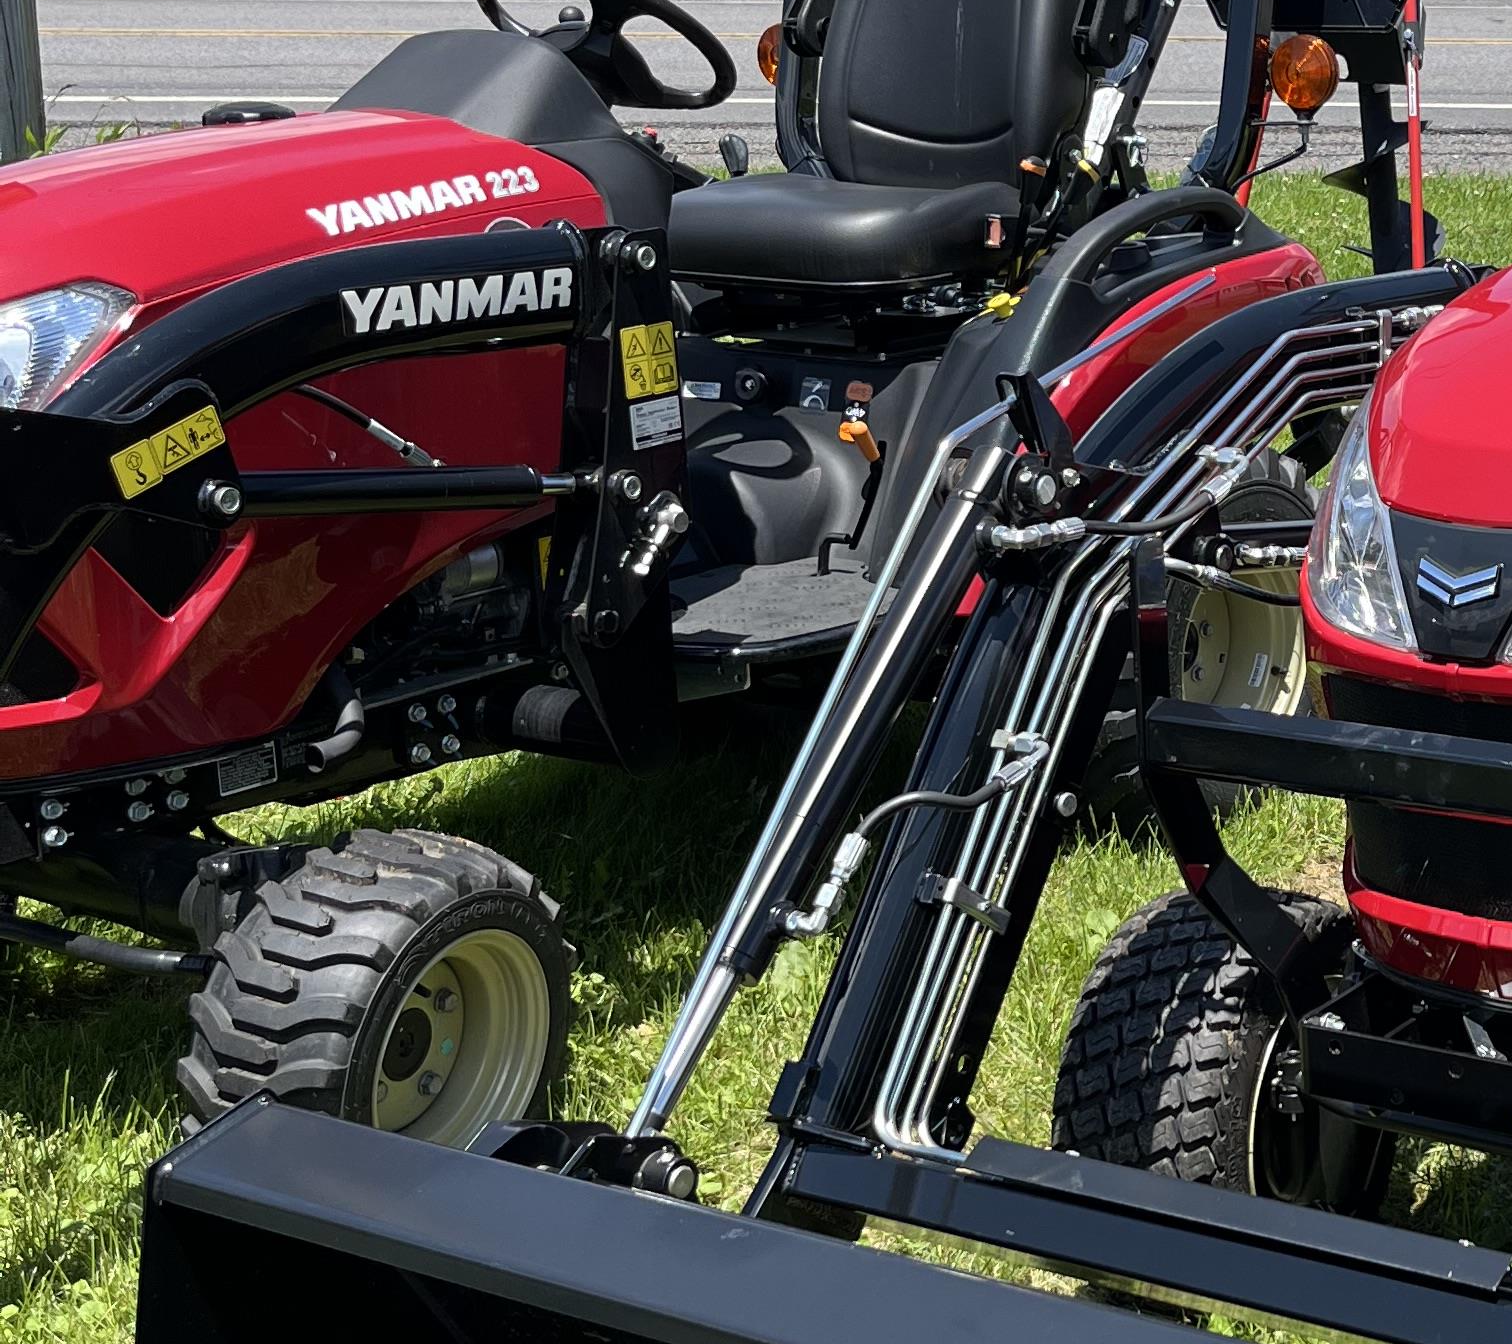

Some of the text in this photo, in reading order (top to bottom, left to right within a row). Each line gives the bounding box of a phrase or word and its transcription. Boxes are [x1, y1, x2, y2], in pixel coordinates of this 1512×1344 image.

[306, 166, 539, 236] YANMAR 223
[341, 267, 573, 334] YANMAR
